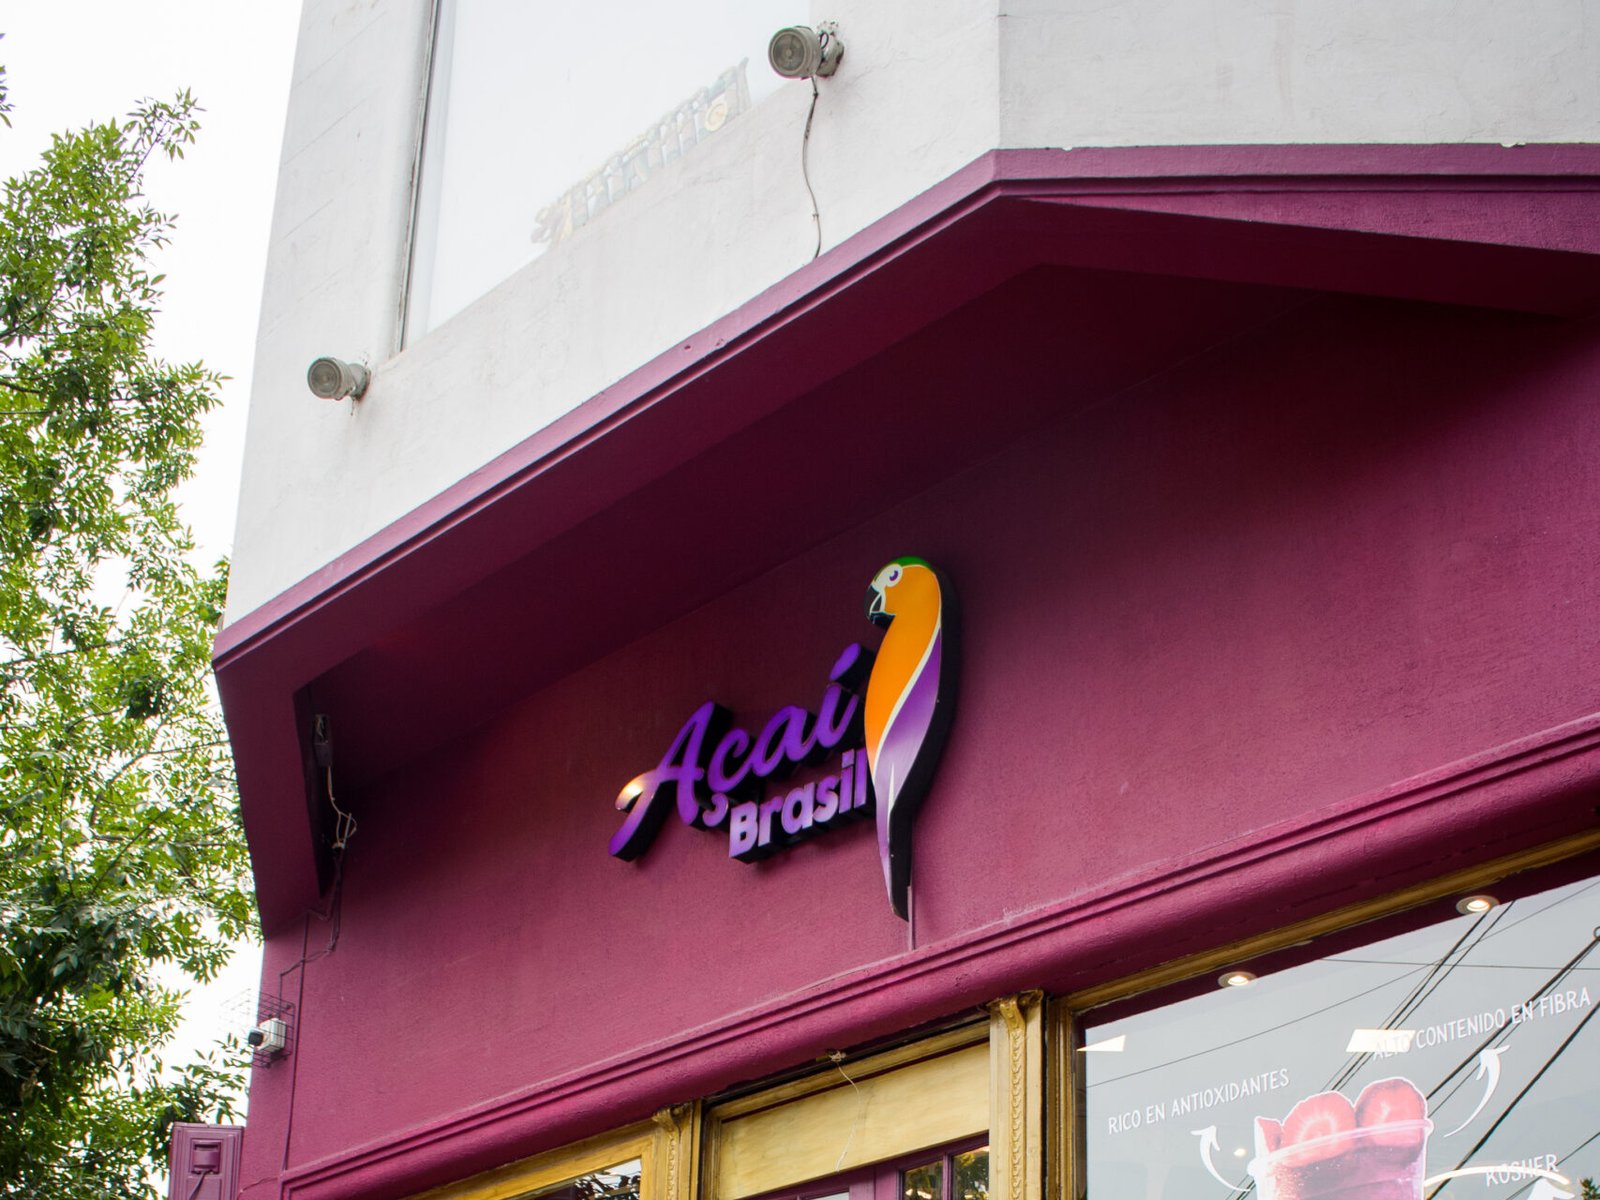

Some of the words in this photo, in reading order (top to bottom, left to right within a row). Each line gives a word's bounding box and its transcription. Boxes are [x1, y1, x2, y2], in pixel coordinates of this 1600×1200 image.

[728, 747, 868, 858] Brasil
[1416, 1007, 1506, 1049] CONTENIDO
[1511, 1001, 1534, 1025] EN
[1540, 986, 1591, 1017] FIBRA
[1108, 1109, 1142, 1135] RICO
[1146, 1102, 1166, 1124] EN
[1170, 1067, 1290, 1118] ANTIOXIDANTES
[1485, 1153, 1561, 1187] KOSHER
